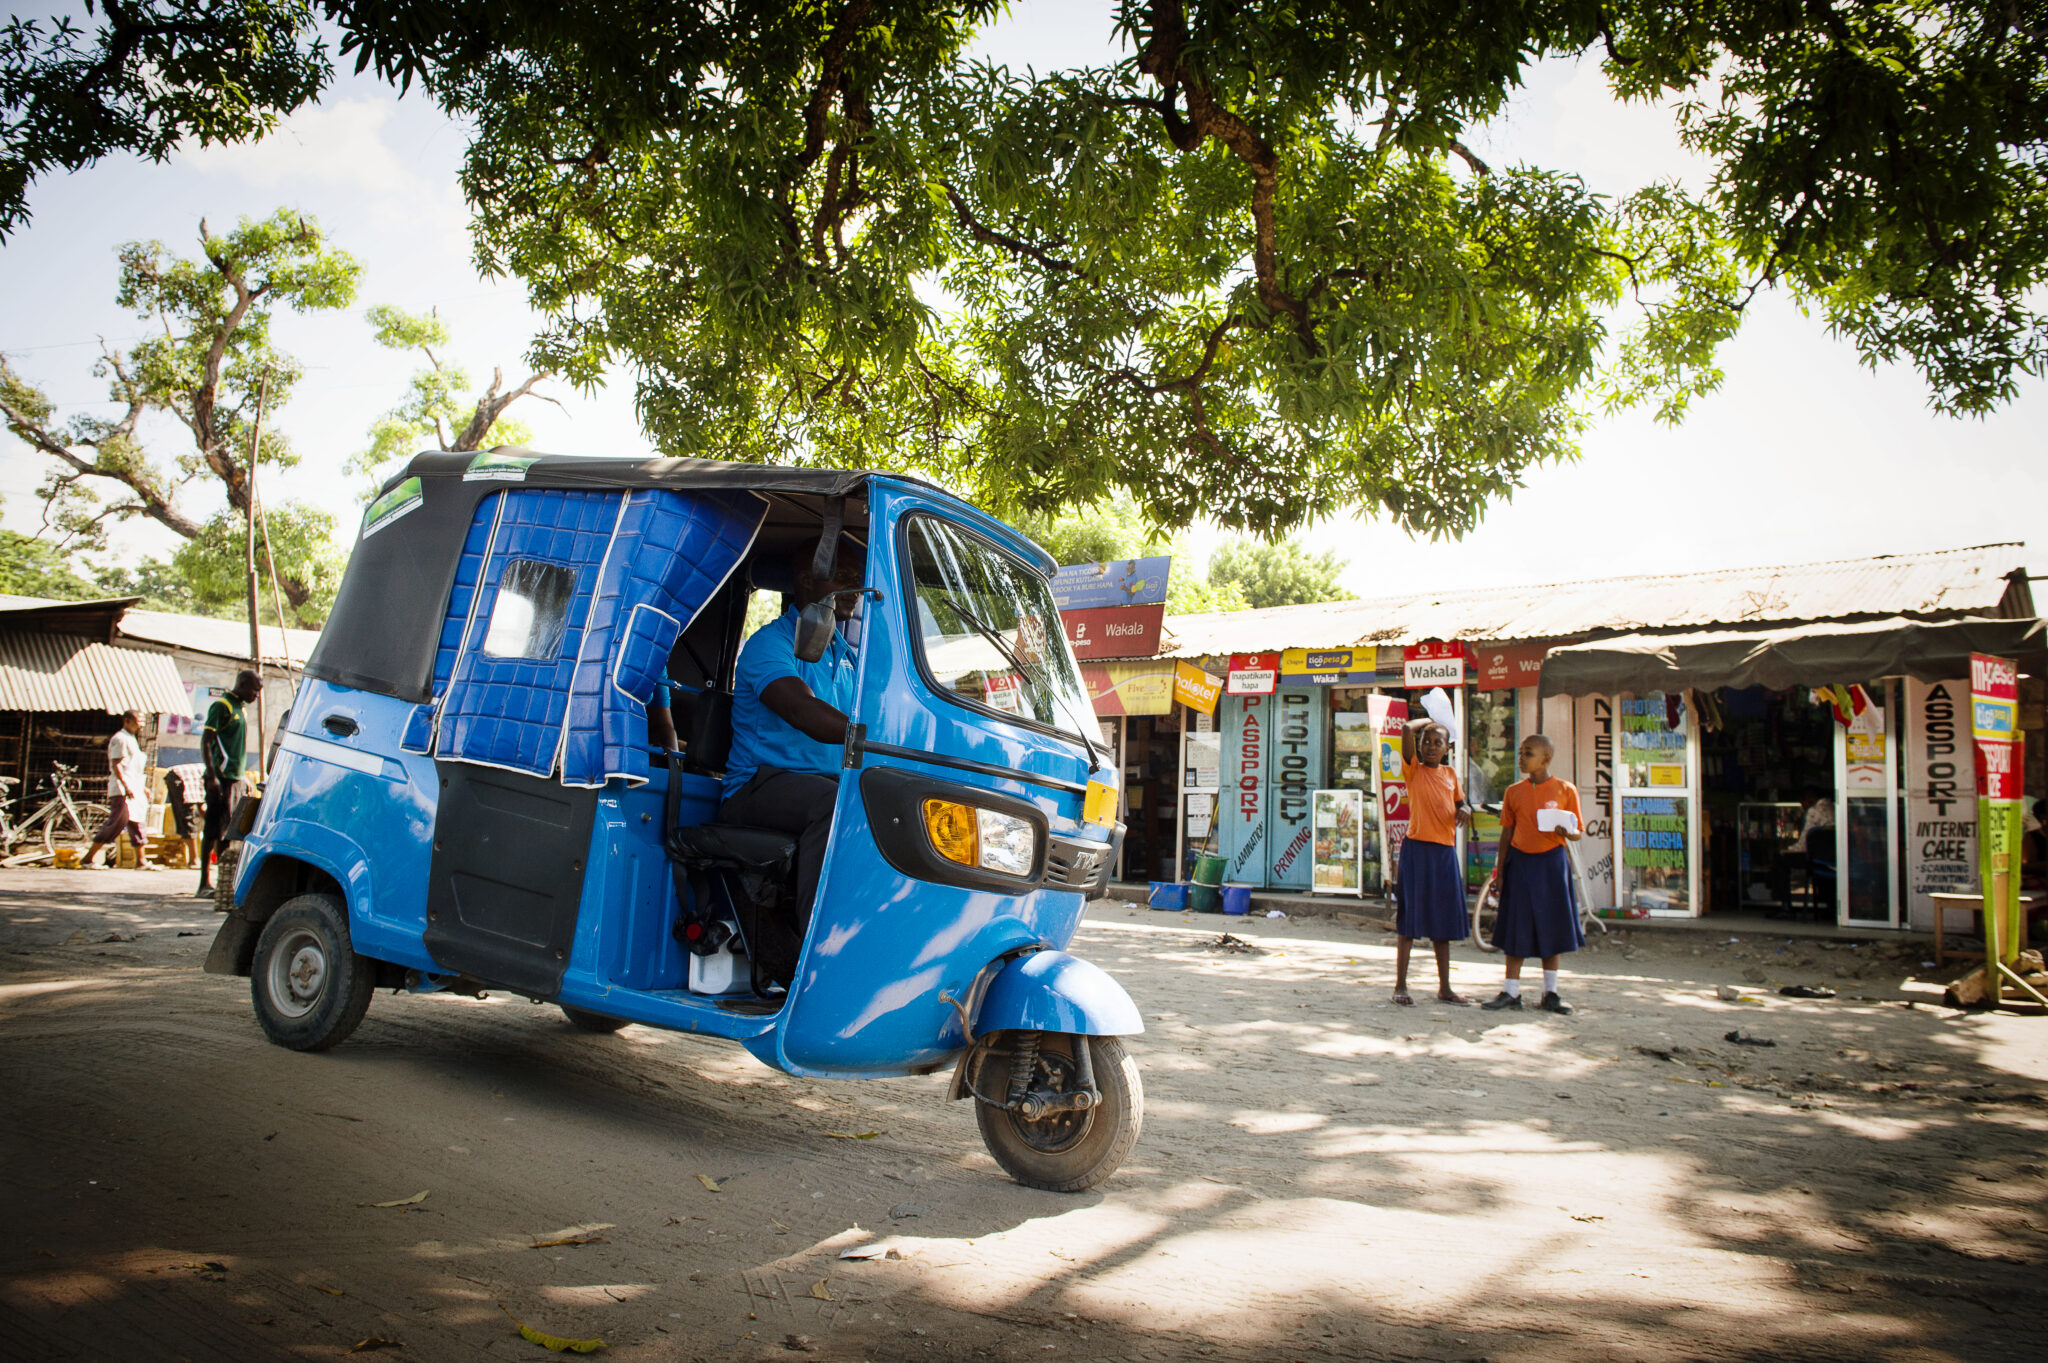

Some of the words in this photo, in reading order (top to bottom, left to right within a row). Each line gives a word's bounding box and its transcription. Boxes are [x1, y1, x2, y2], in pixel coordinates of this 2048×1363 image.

[1105, 622, 1144, 637] Wakala
[1231, 672, 1272, 680] Inapatikana
[1410, 664, 1457, 679] Wakala
[1488, 666, 1508, 675] airtel
[1242, 683, 1259, 691] hapa
[1240, 696, 1261, 822] PASSPORT
[1280, 694, 1309, 827] PHOTOCOPY
[1623, 797, 1676, 814] SCANNING
[1916, 822, 1977, 837] INTERNET
[1648, 831, 1684, 849] RUSHA
[1273, 826, 1312, 880] PRINTING
[1922, 840, 1966, 860] CAFE
[1920, 864, 1969, 873] SCANNING
[1926, 875, 1969, 884] PRINTING
